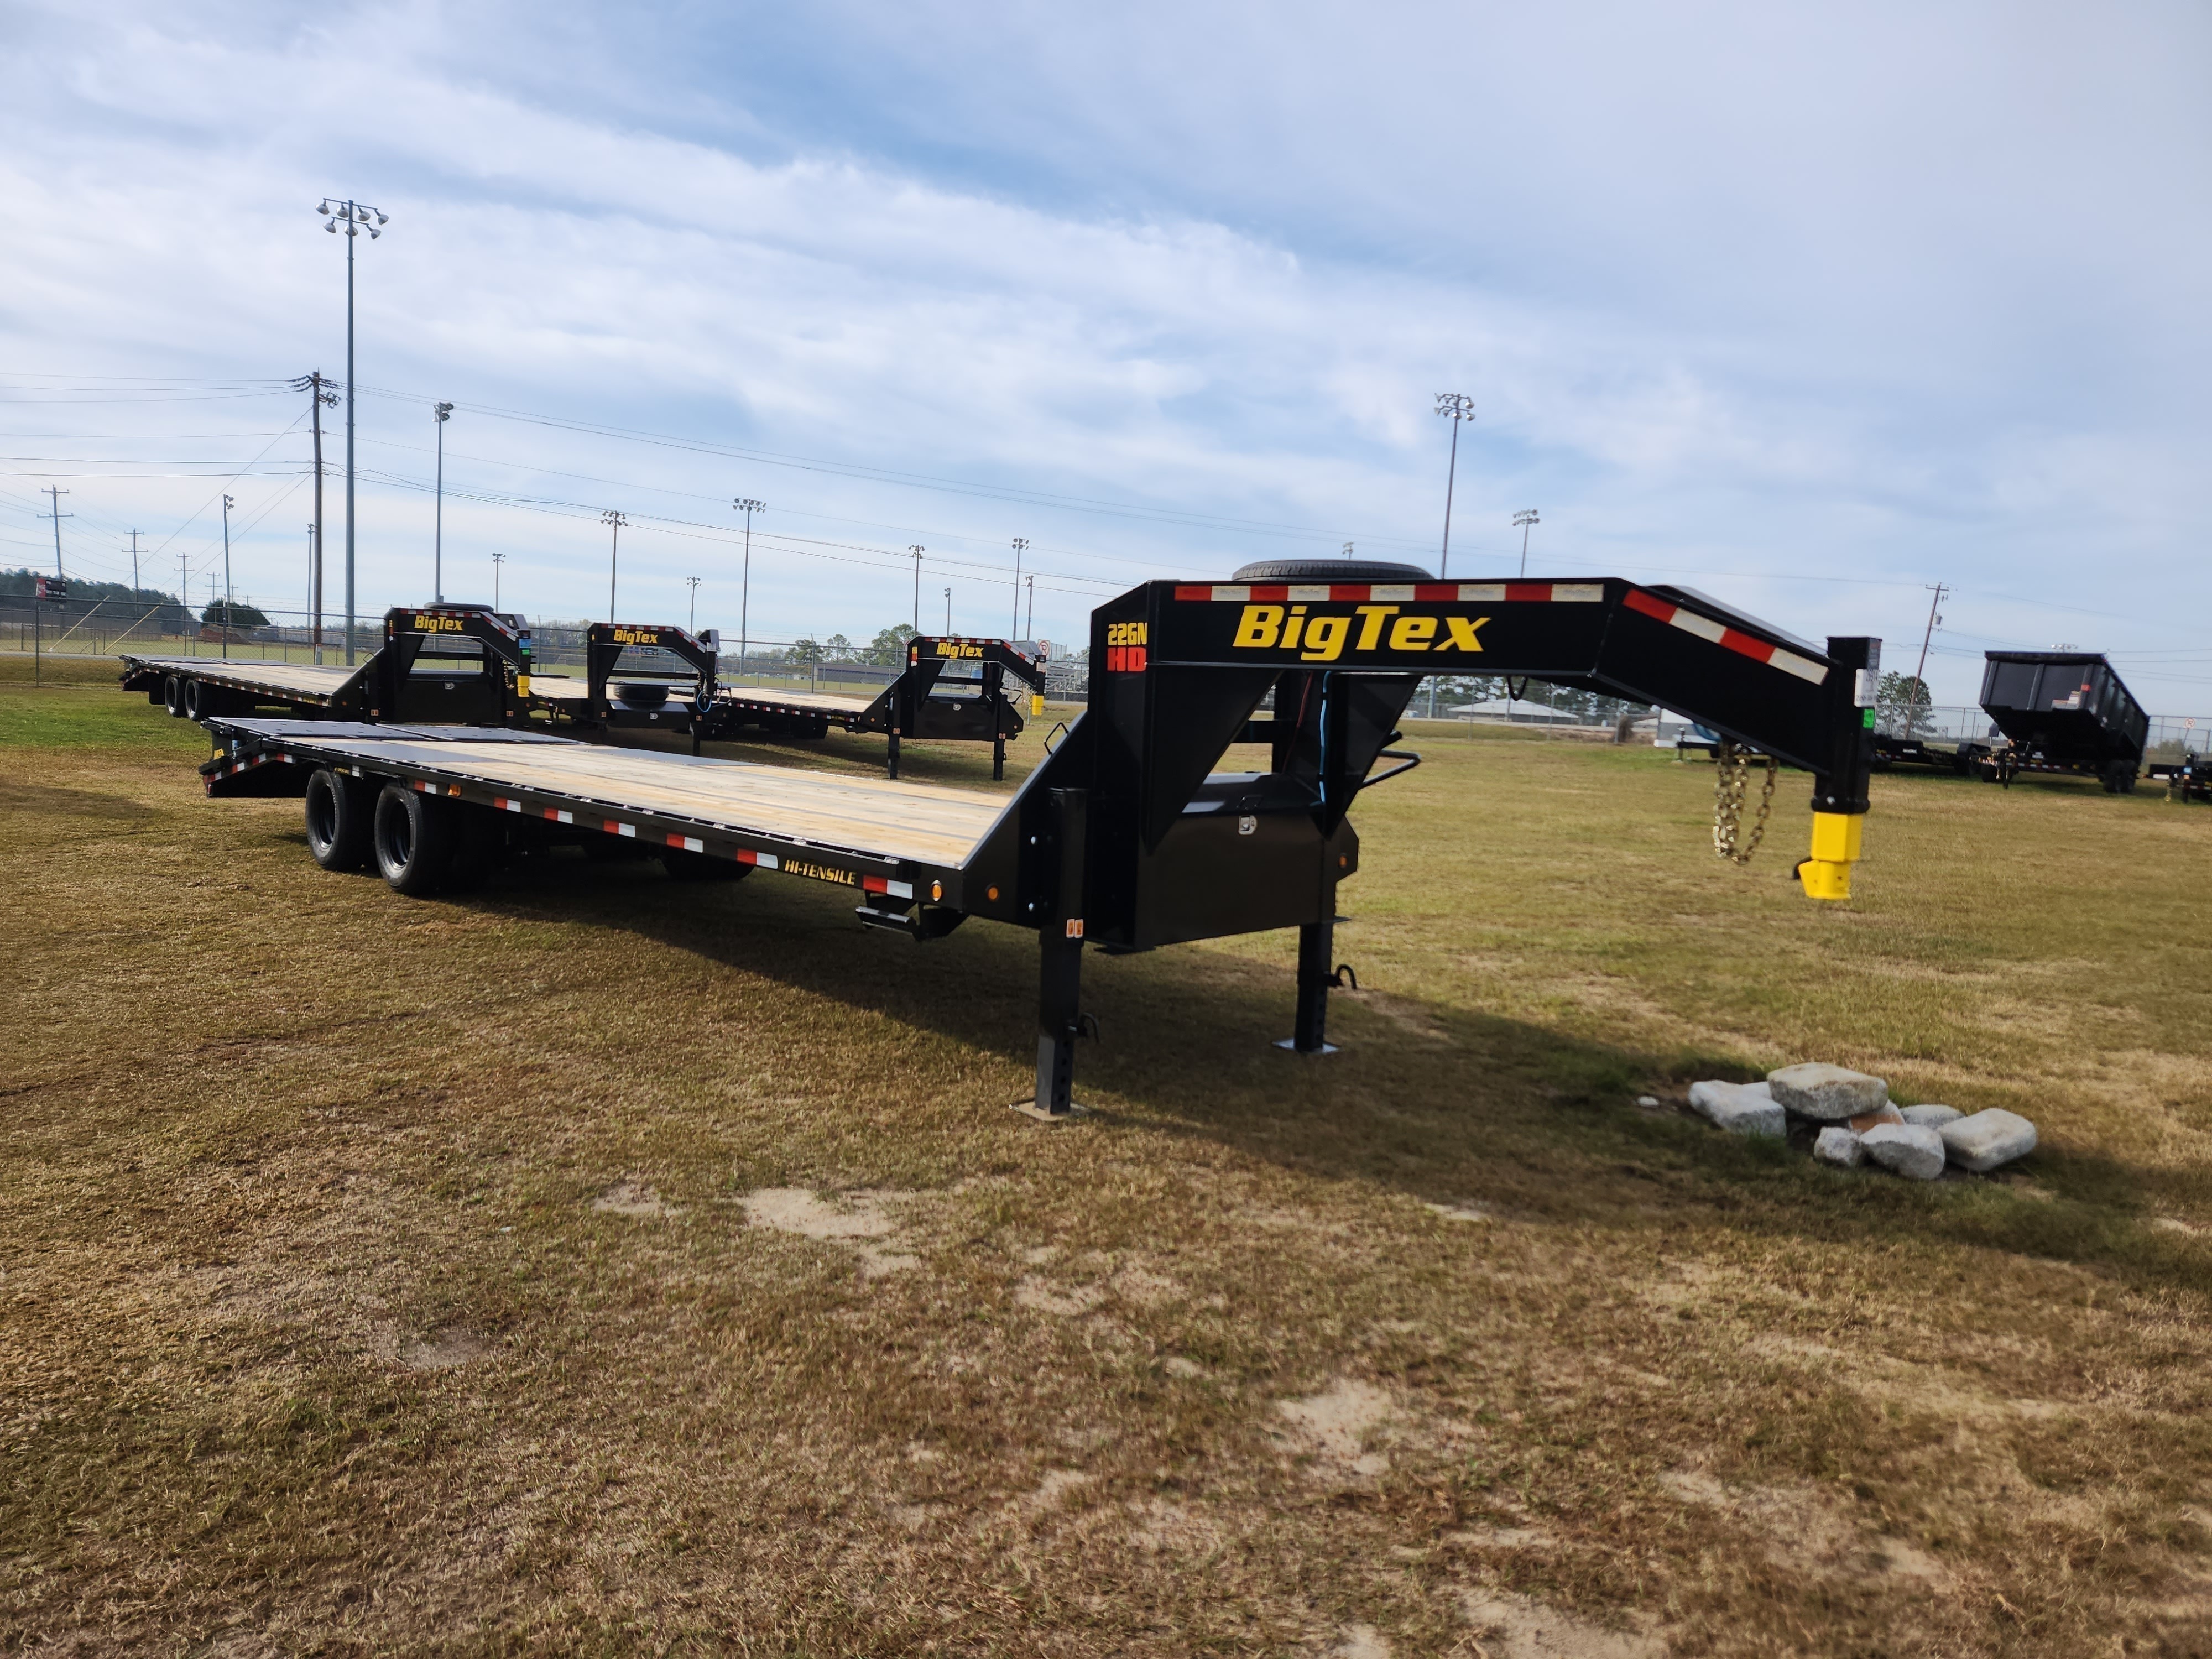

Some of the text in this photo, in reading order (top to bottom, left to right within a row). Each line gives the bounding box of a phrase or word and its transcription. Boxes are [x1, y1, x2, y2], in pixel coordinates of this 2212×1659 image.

[414, 615, 463, 633] BigTex
[1232, 605, 1491, 661] BigTex
[613, 629, 658, 645] BigTex
[936, 642, 984, 659] BigTex
[1108, 647, 1147, 671] HD
[785, 859, 856, 885] HI-TENSILE
